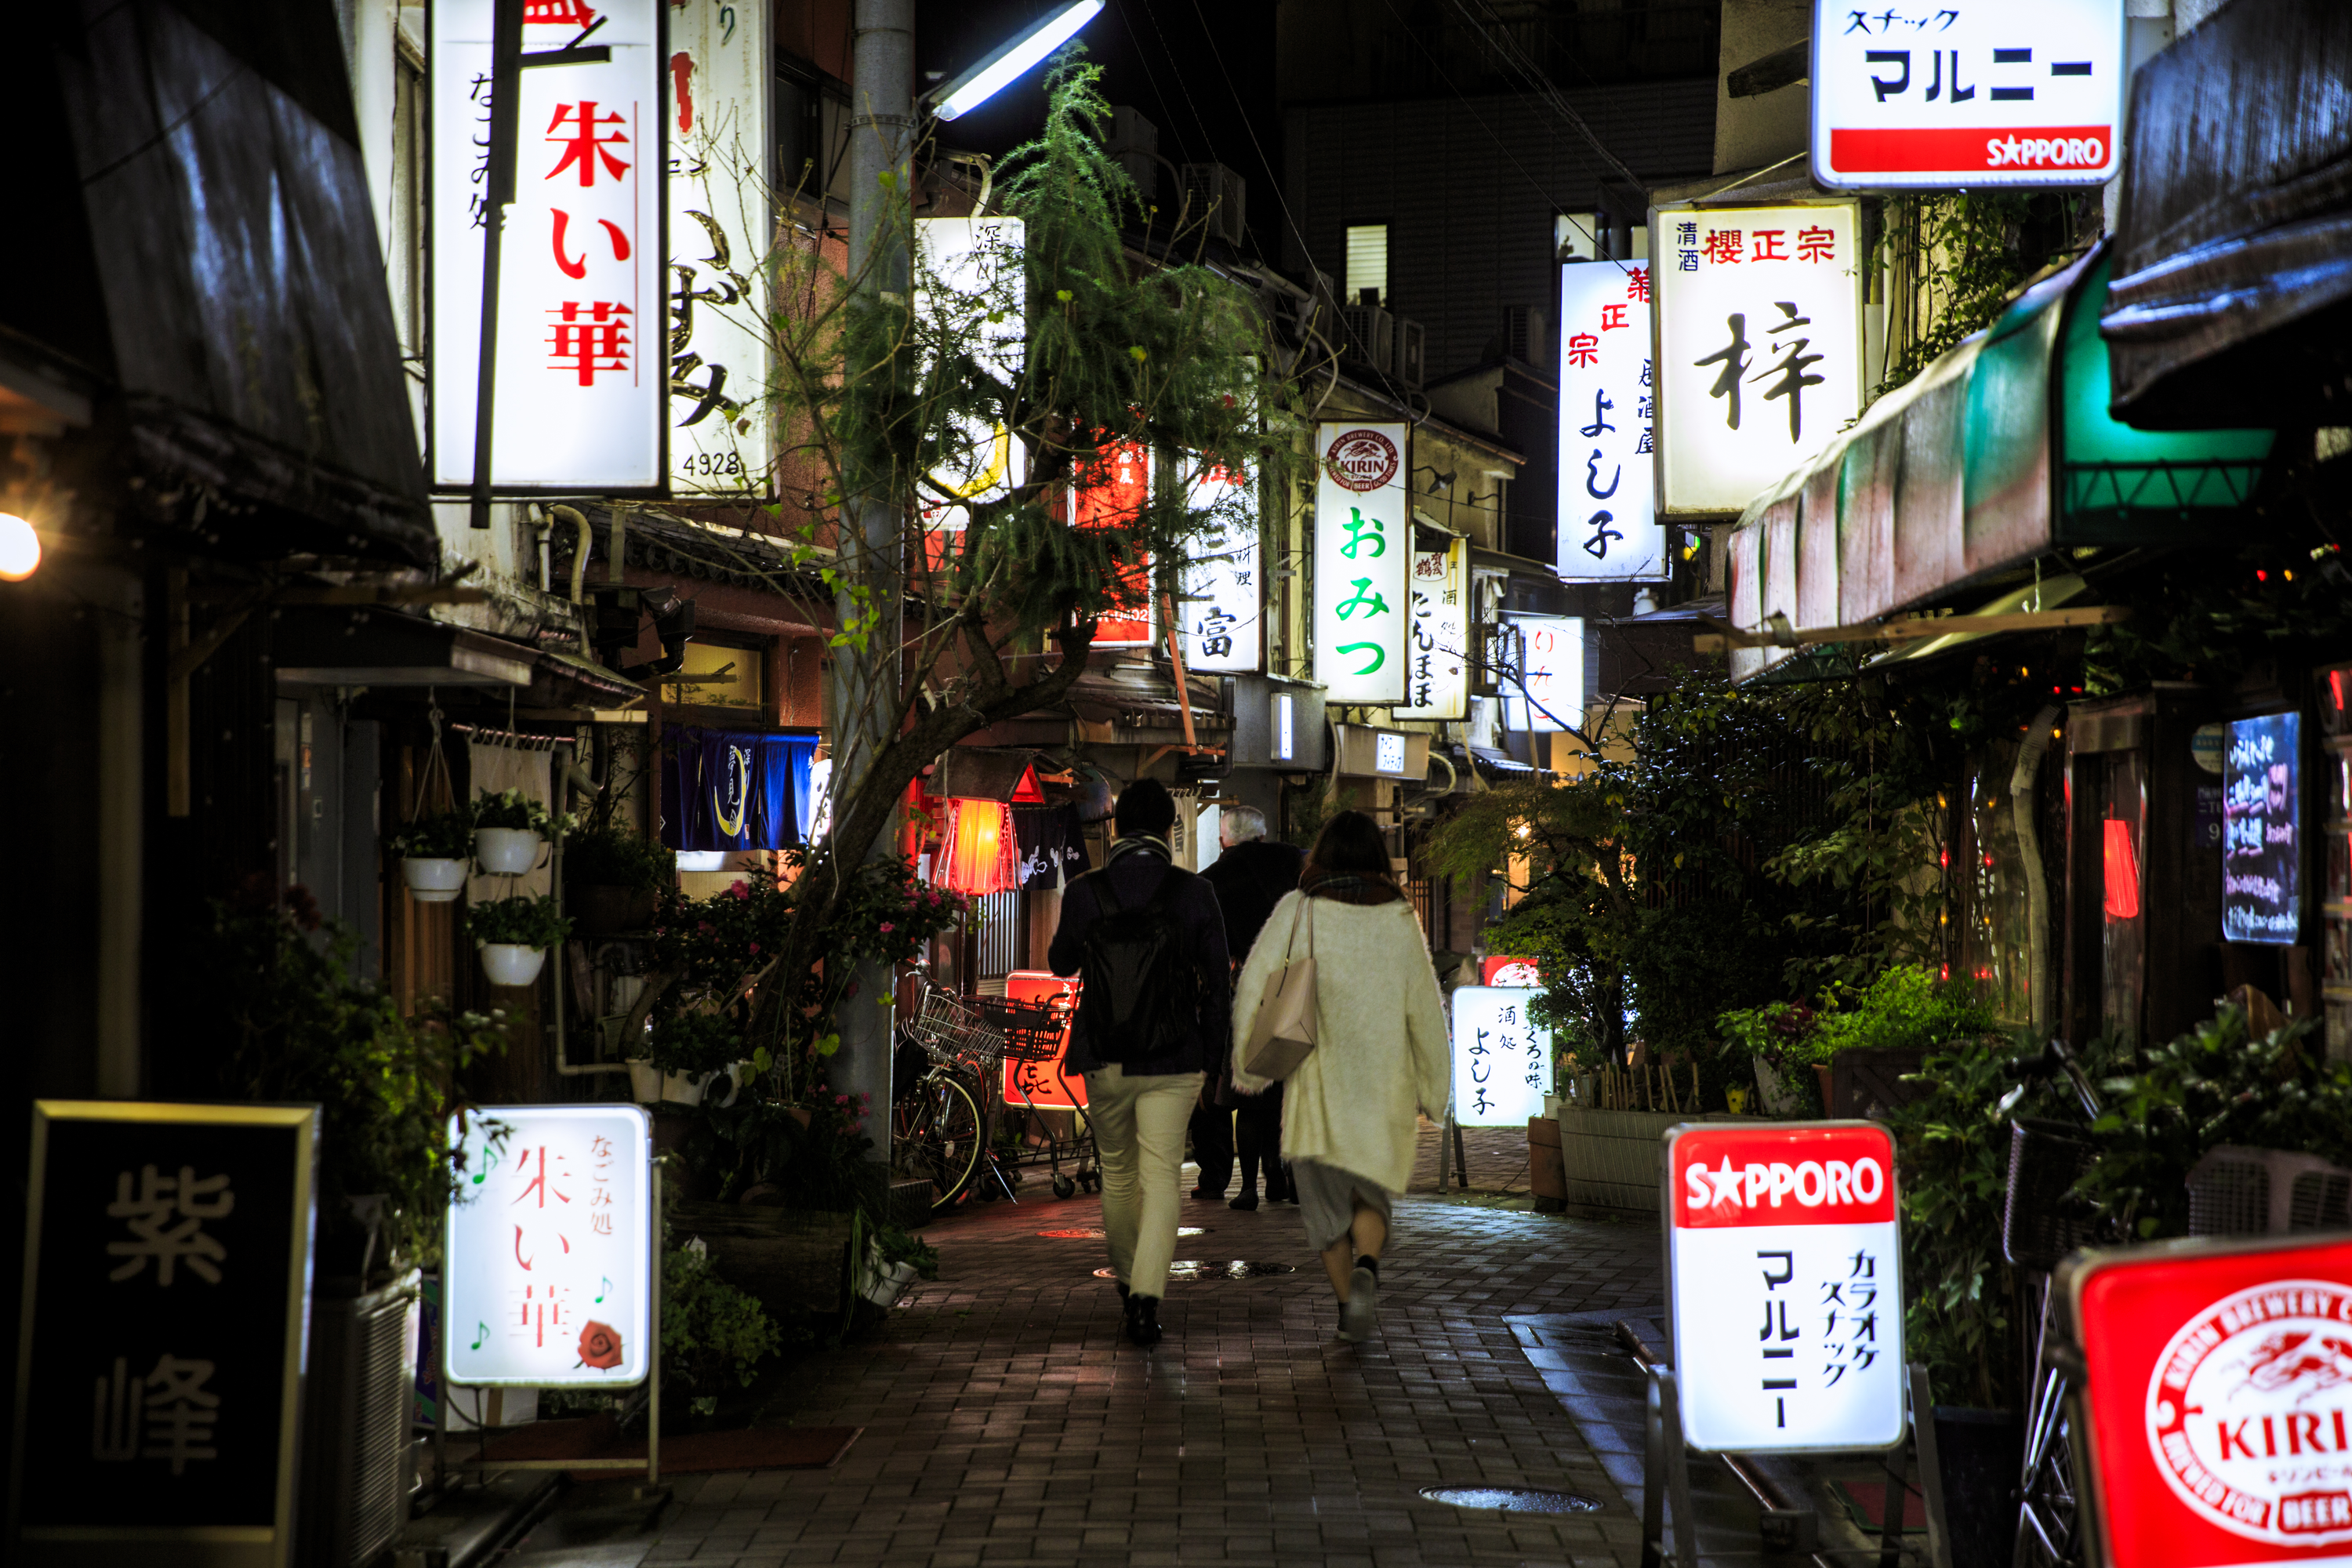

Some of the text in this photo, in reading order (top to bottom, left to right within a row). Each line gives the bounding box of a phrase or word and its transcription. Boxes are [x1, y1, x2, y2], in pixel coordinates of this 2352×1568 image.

[1842, 8, 1960, 36] スナック
[1864, 47, 2092, 104] マルニー
[544, 100, 633, 387] 朱い華
[1676, 221, 1699, 272] 清酒
[1701, 225, 1835, 265] 櫻正宗
[1693, 301, 1826, 445] 梓
[1330, 437, 1346, 453] KIRIN
[1346, 431, 1374, 440] BREWERY
[1341, 460, 1385, 473] KIRIN
[1579, 388, 1624, 560] よし子
[1335, 506, 1390, 675] おみつ
[1468, 1027, 1495, 1116] よし子
[1498, 1005, 1517, 1051] 酒処
[590, 1134, 614, 1236] なごみ処
[509, 1145, 572, 1348] 朱い華
[93, 1163, 234, 1477] 紫峰
[1756, 1250, 1800, 1428] マルニー
[1817, 1280, 1847, 1388] スナック
[1848, 1248, 1880, 1371] カラオケ
[2218, 1290, 2332, 1334] BREWERY
[2221, 1490, 2267, 1525] FOR
[2282, 1494, 2352, 1530] BEER
